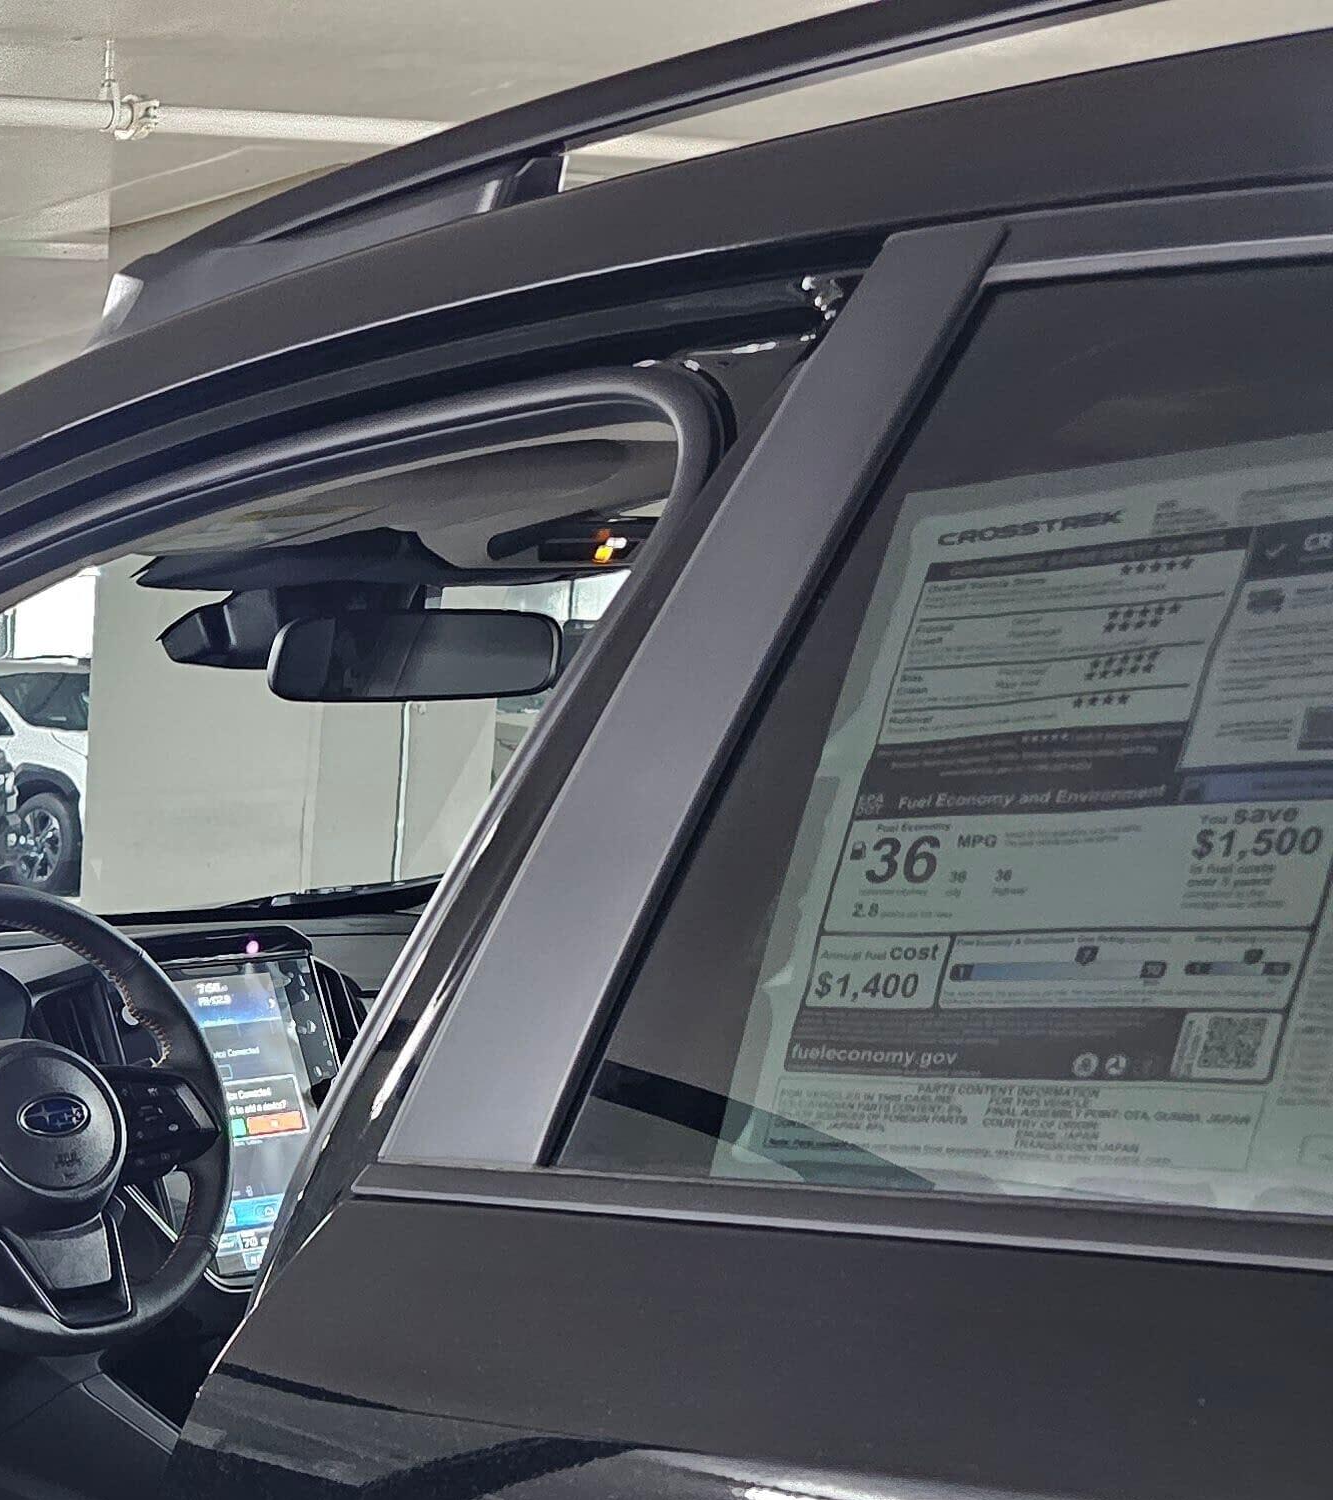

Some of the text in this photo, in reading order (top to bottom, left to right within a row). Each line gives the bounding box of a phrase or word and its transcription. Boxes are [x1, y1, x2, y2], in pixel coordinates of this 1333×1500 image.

[937, 509, 1126, 547] CROSSTREK
[898, 784, 1166, 810] Fuel Economy and Environment
[1234, 807, 1300, 824] save
[1192, 825, 1324, 861] $1,500
[865, 835, 941, 884] 36
[957, 834, 998, 849] MPG
[889, 943, 939, 961] cost
[815, 971, 920, 1002] $1,400
[791, 1043, 958, 1068] fueleconomy.gov
